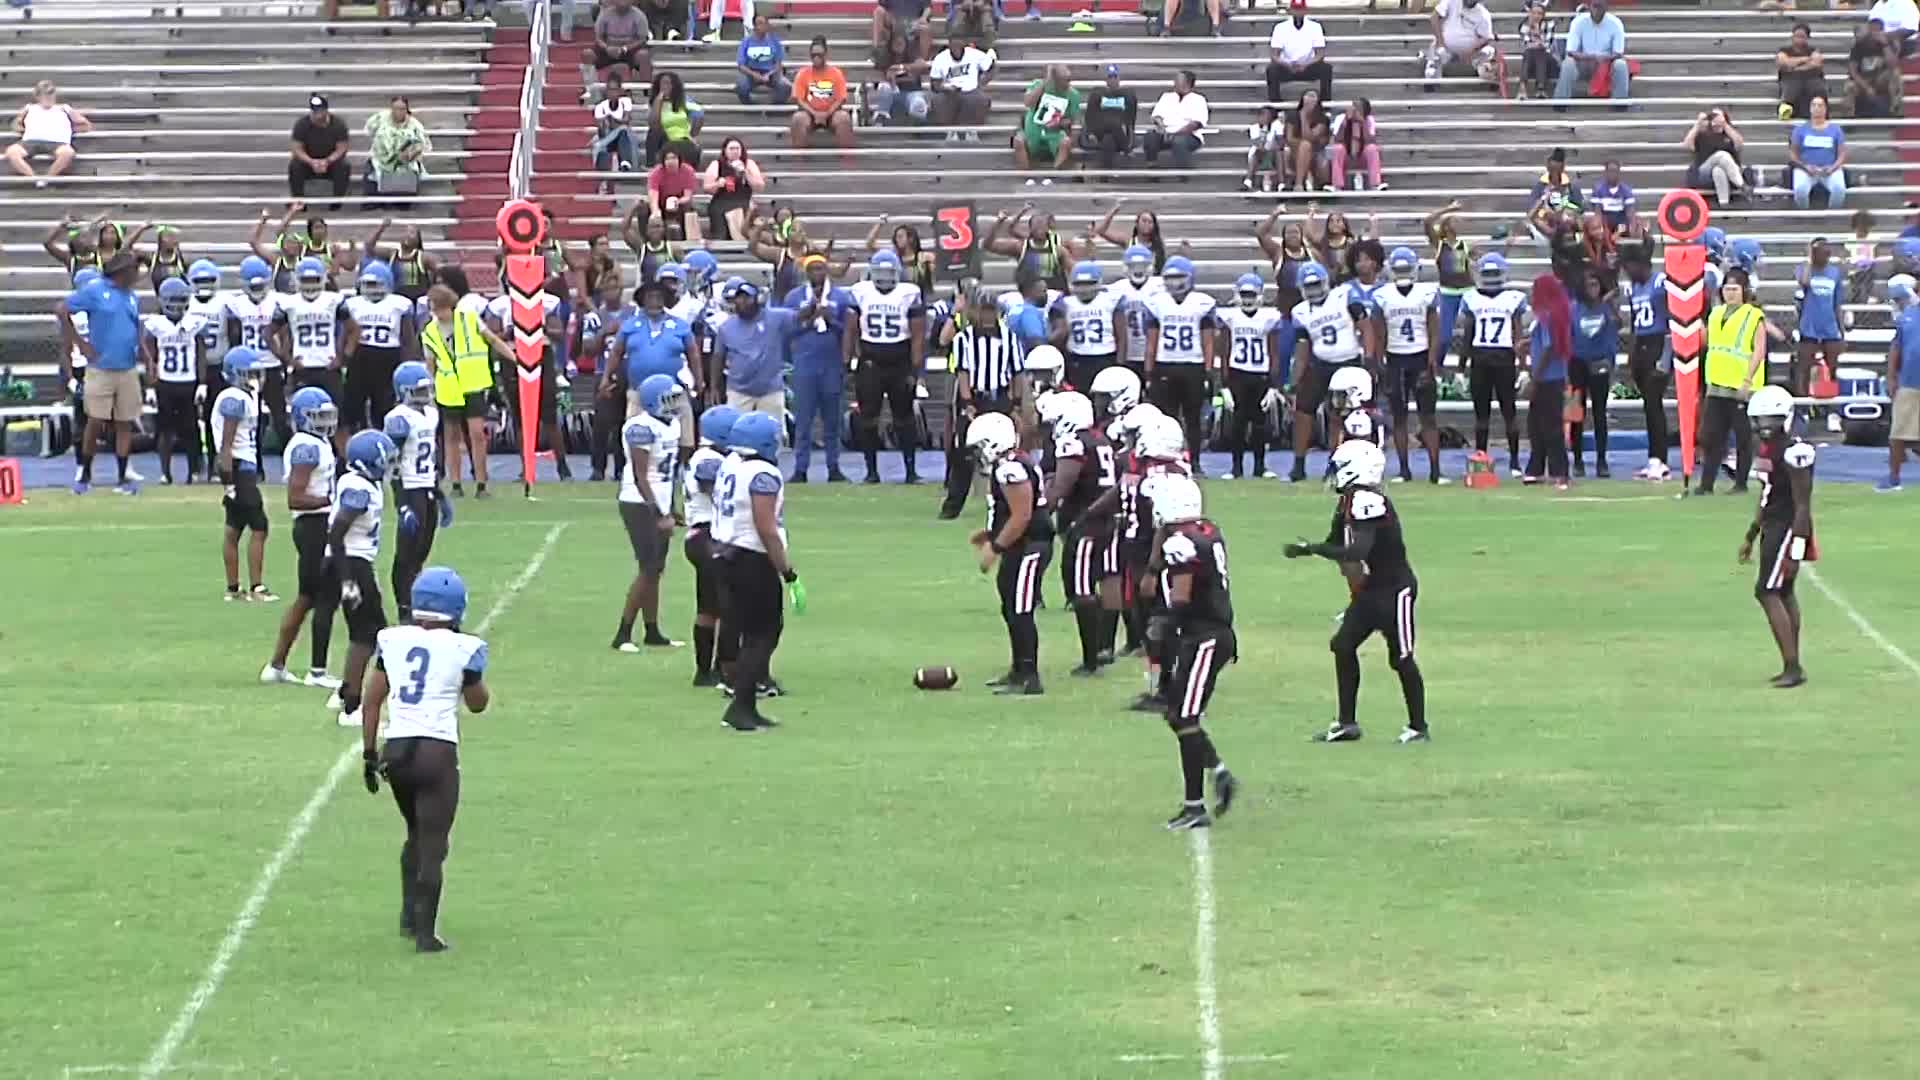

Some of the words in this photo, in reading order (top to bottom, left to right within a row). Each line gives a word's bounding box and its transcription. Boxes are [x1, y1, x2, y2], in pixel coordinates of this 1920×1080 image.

[938, 207, 973, 249] 3
[297, 322, 330, 347] 25
[867, 313, 901, 338] 55
[1072, 319, 1104, 345] 63
[1163, 325, 1194, 351] 58
[1321, 325, 1337, 345] 9
[1400, 318, 1415, 343] 4
[1480, 317, 1505, 344] 17
[163, 345, 190, 373] 81
[1234, 337, 1264, 365] 30
[416, 442, 431, 474] 2
[400, 646, 430, 705] 3
